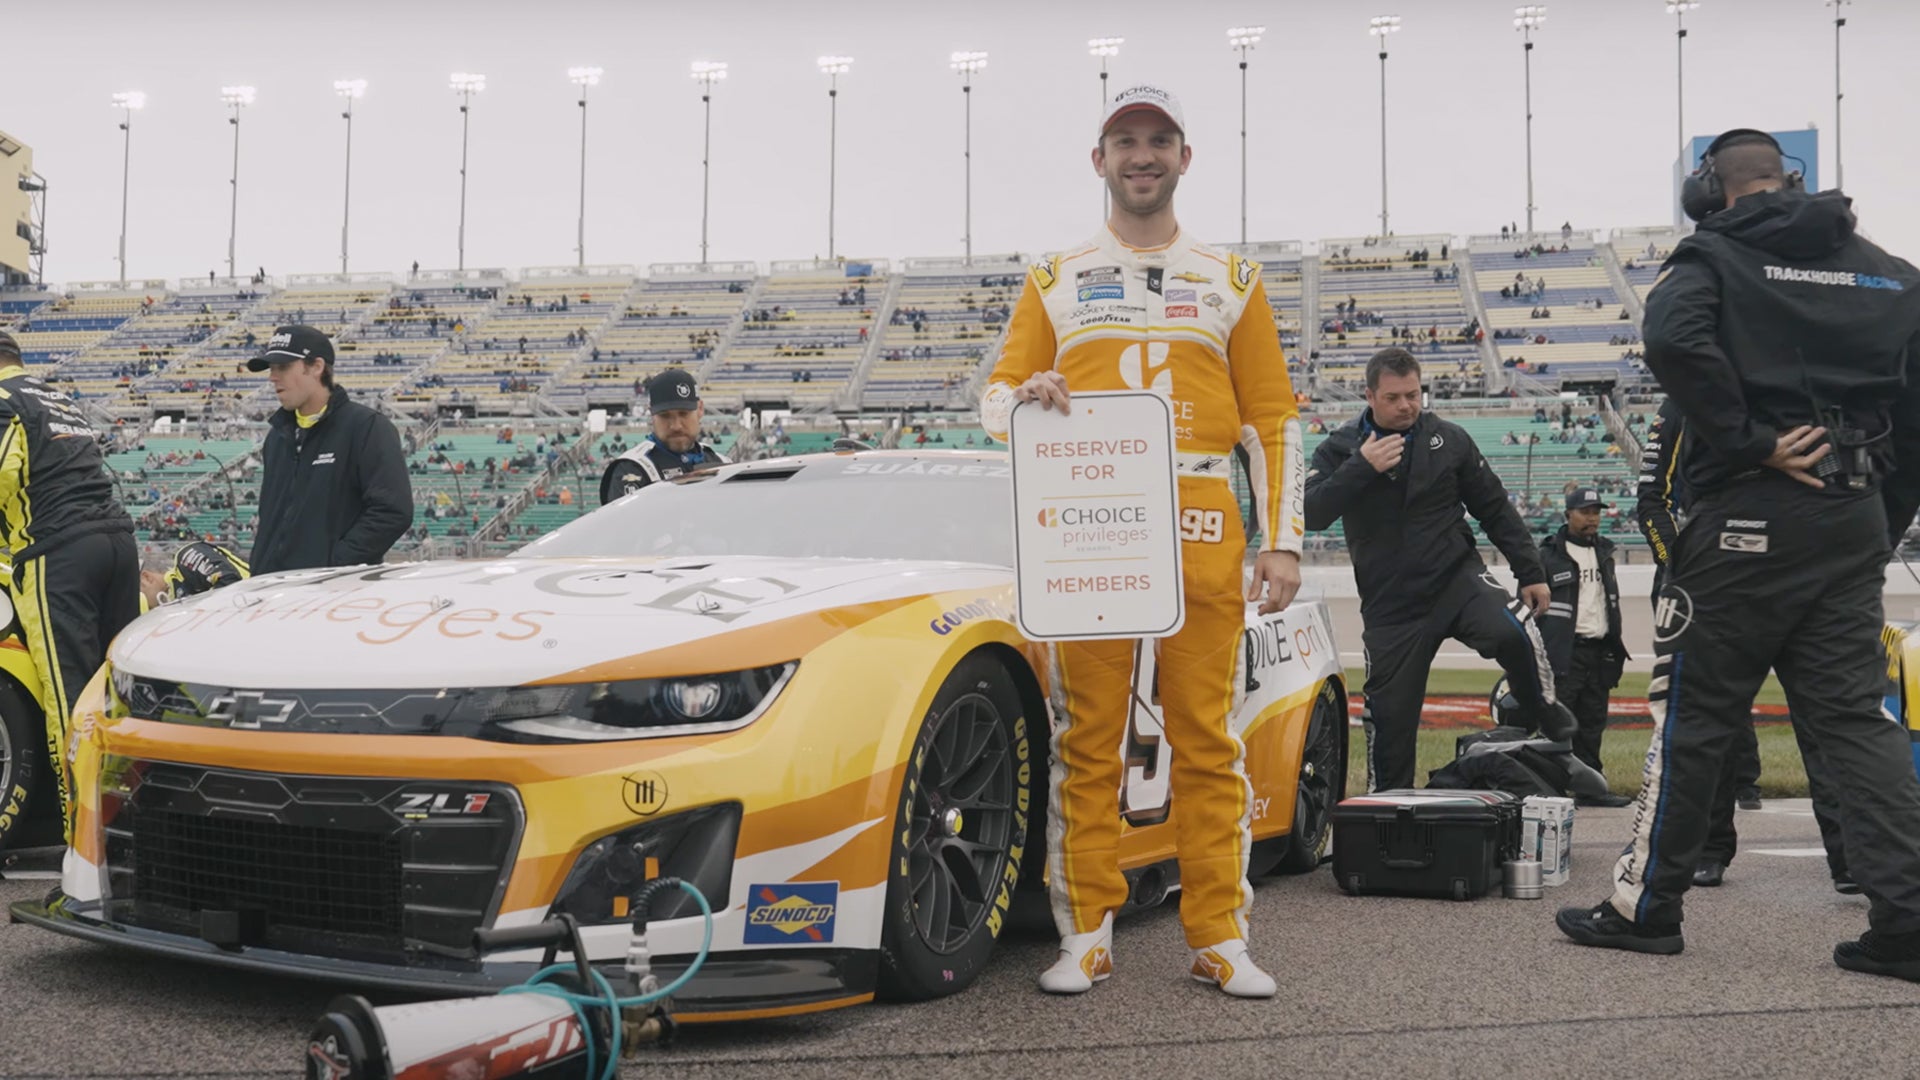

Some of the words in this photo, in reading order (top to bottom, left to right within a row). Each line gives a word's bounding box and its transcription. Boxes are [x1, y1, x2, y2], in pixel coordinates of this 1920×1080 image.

[1125, 86, 1170, 101] CHOICE
[1763, 265, 1857, 286] TRACKHOUSE
[1080, 313, 1132, 326] GOODYEAR
[1035, 439, 1148, 458] RESERVED
[1071, 464, 1115, 481] FOR
[1061, 507, 1147, 525] CHOICE
[1181, 508, 1225, 544] 99
[1062, 526, 1149, 548] privileges
[1046, 574, 1151, 594] MEMBERS
[125, 587, 557, 662] privileges
[0, 784, 28, 832] EAG
[393, 793, 491, 814] ZL1
[986, 715, 1030, 939] GOODYEAR
[751, 906, 832, 923] SUNOCO
